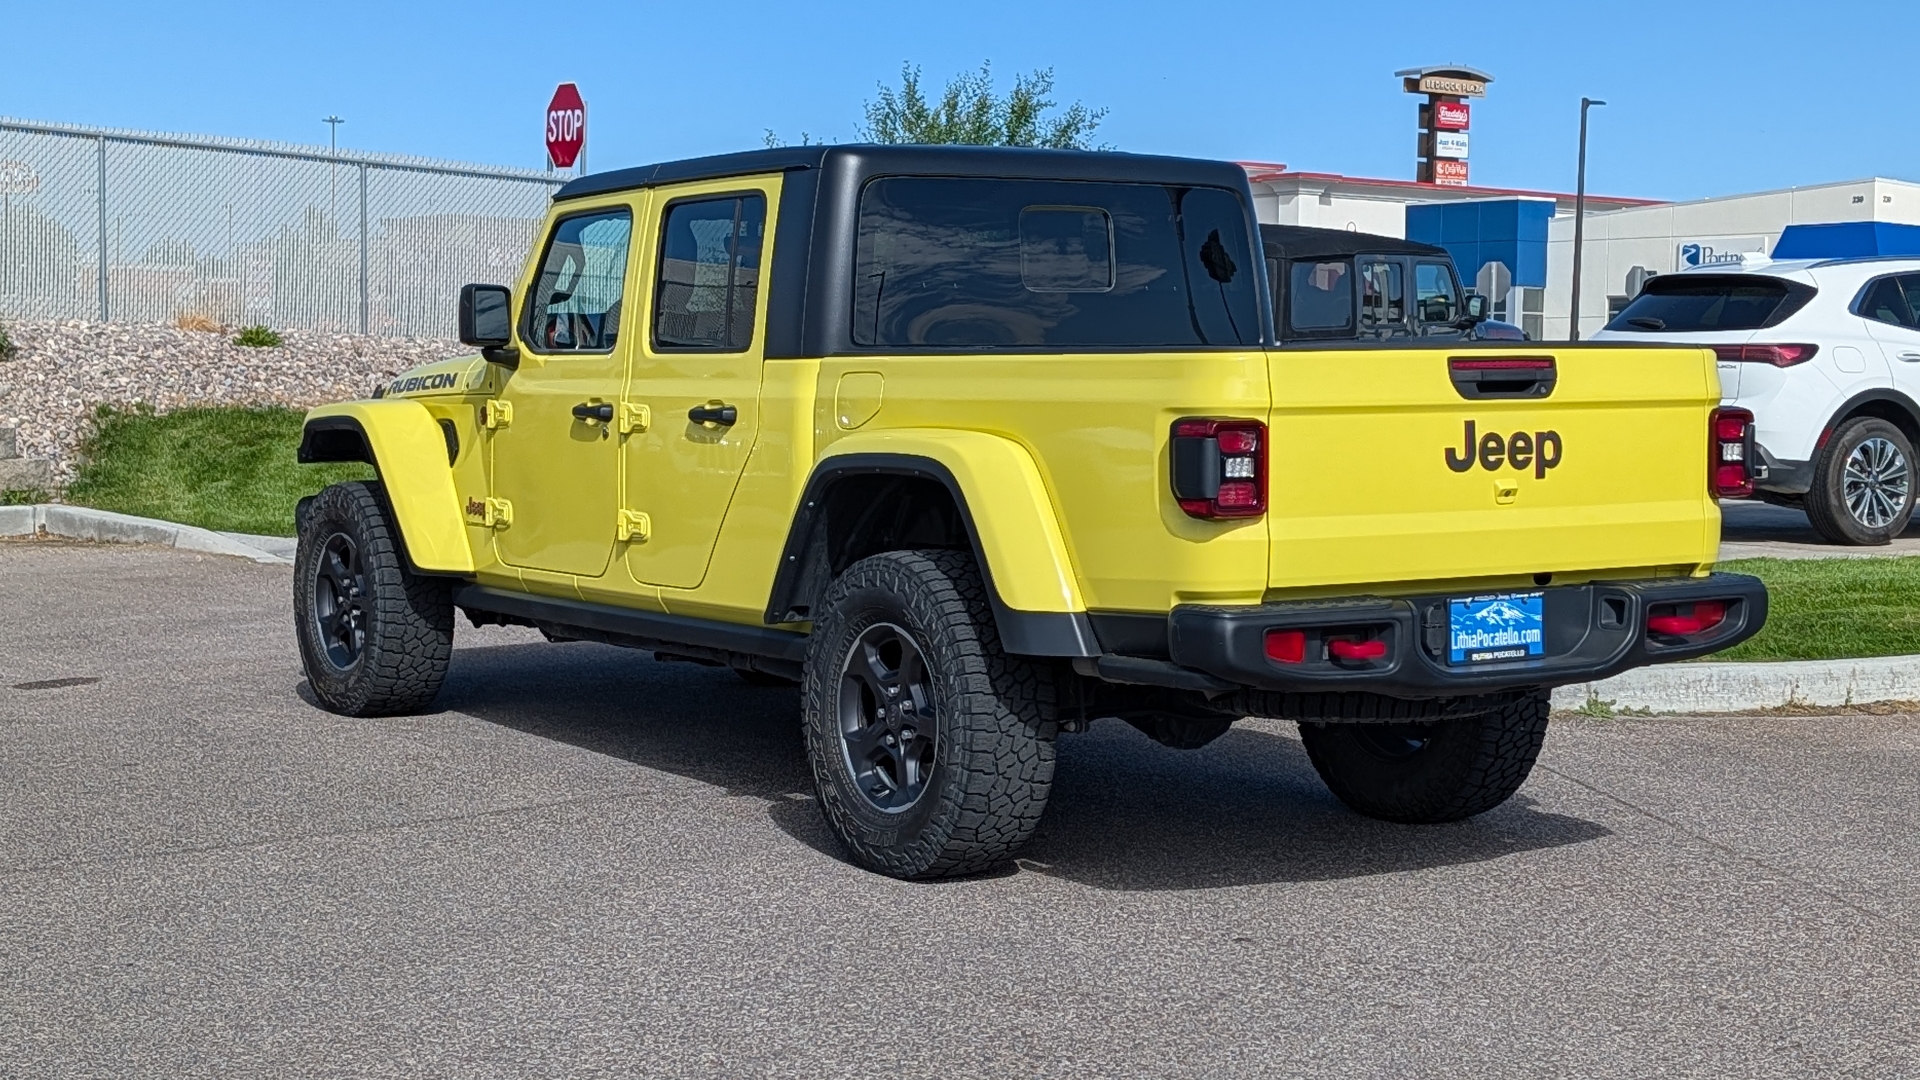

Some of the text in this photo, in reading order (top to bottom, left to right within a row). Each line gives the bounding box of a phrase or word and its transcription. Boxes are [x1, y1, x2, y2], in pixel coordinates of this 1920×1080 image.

[1426, 80, 1485, 94] BEDROCK PLAZA
[548, 109, 582, 142] STOP
[387, 372, 458, 396] RUBICON
[1444, 419, 1563, 480] Jeep
[466, 496, 485, 520] Jeep
[1451, 627, 1541, 650] LithiaPocatello.com
